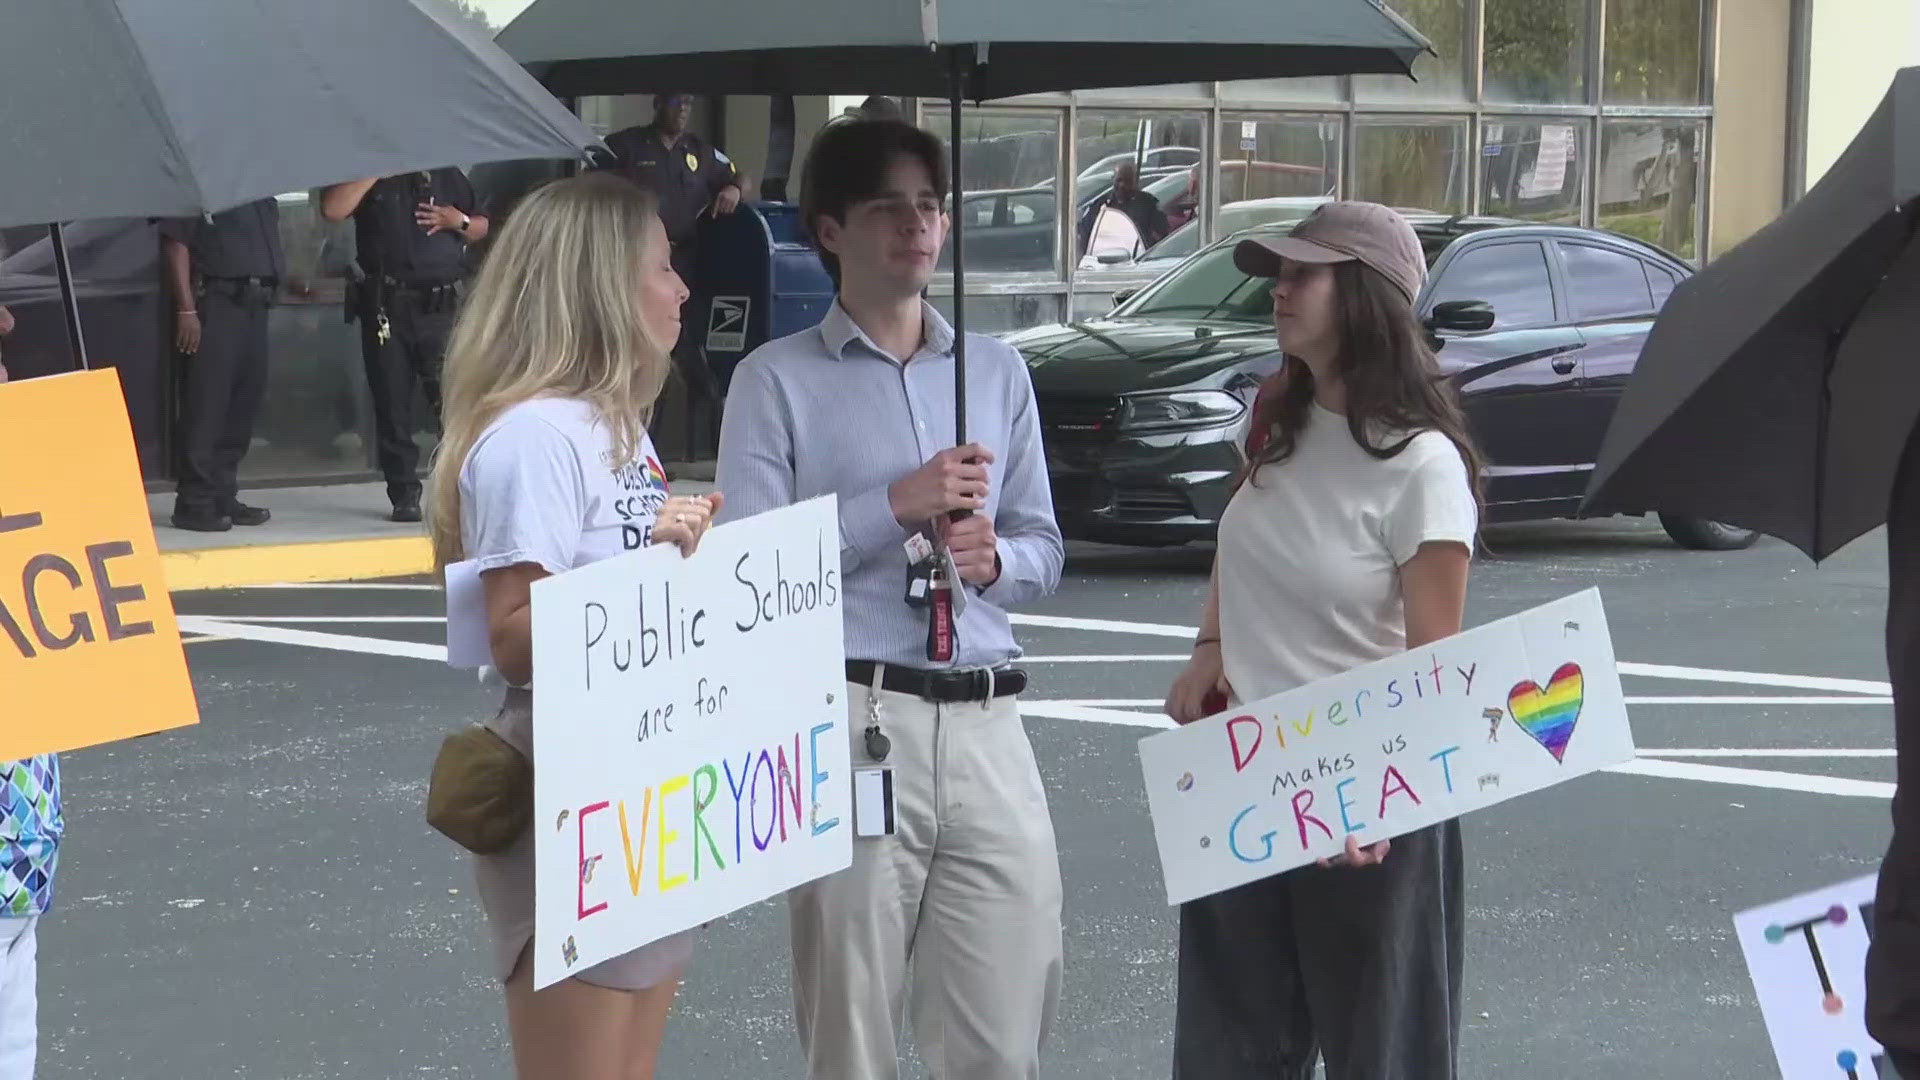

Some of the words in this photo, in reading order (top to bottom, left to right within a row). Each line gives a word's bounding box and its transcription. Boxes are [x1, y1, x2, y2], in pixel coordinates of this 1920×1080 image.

[585, 581, 706, 691] Public
[736, 528, 838, 633] Schools
[637, 705, 674, 742] are
[694, 678, 728, 717] for
[1226, 653, 1477, 774] Diversity
[1382, 733, 1407, 755] us
[577, 722, 839, 921] EVERYONE
[1228, 746, 1461, 863] GREAT
